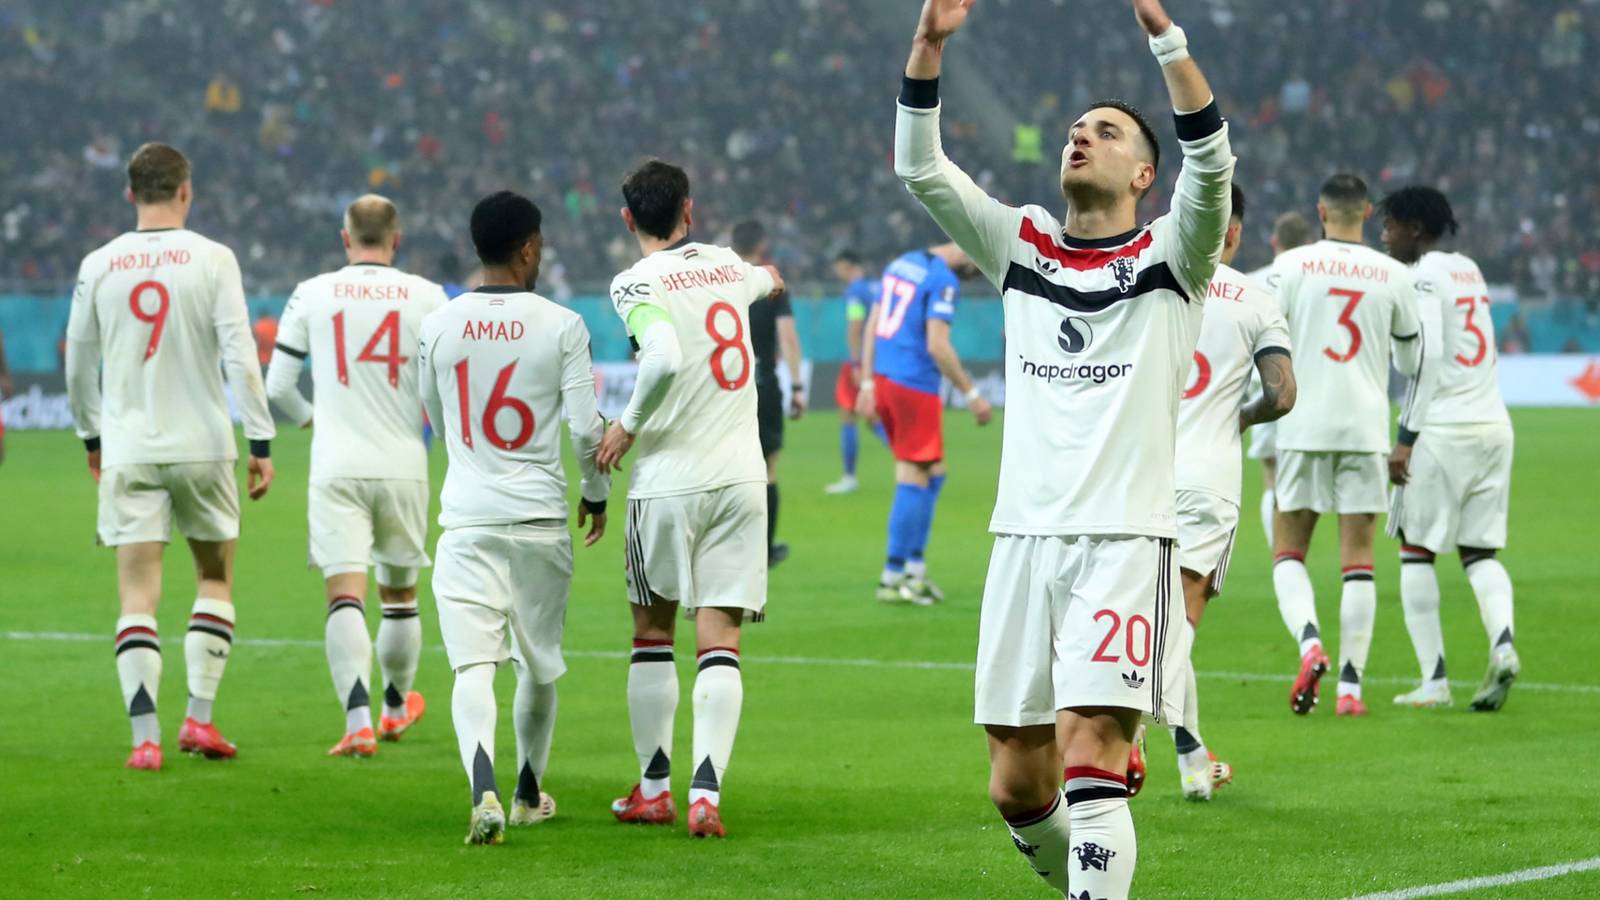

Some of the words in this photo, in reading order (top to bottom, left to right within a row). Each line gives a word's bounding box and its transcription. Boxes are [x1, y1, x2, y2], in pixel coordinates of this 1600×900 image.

[333, 283, 410, 301] ERIKSEN
[1301, 260, 1389, 283] MAZRAOUI
[128, 279, 171, 363] 9
[331, 309, 409, 390] 14
[462, 319, 526, 342] AMAD
[704, 299, 751, 393] 8
[1323, 287, 1365, 364] 3
[454, 357, 536, 452] 16
[1091, 608, 1152, 668] 20
